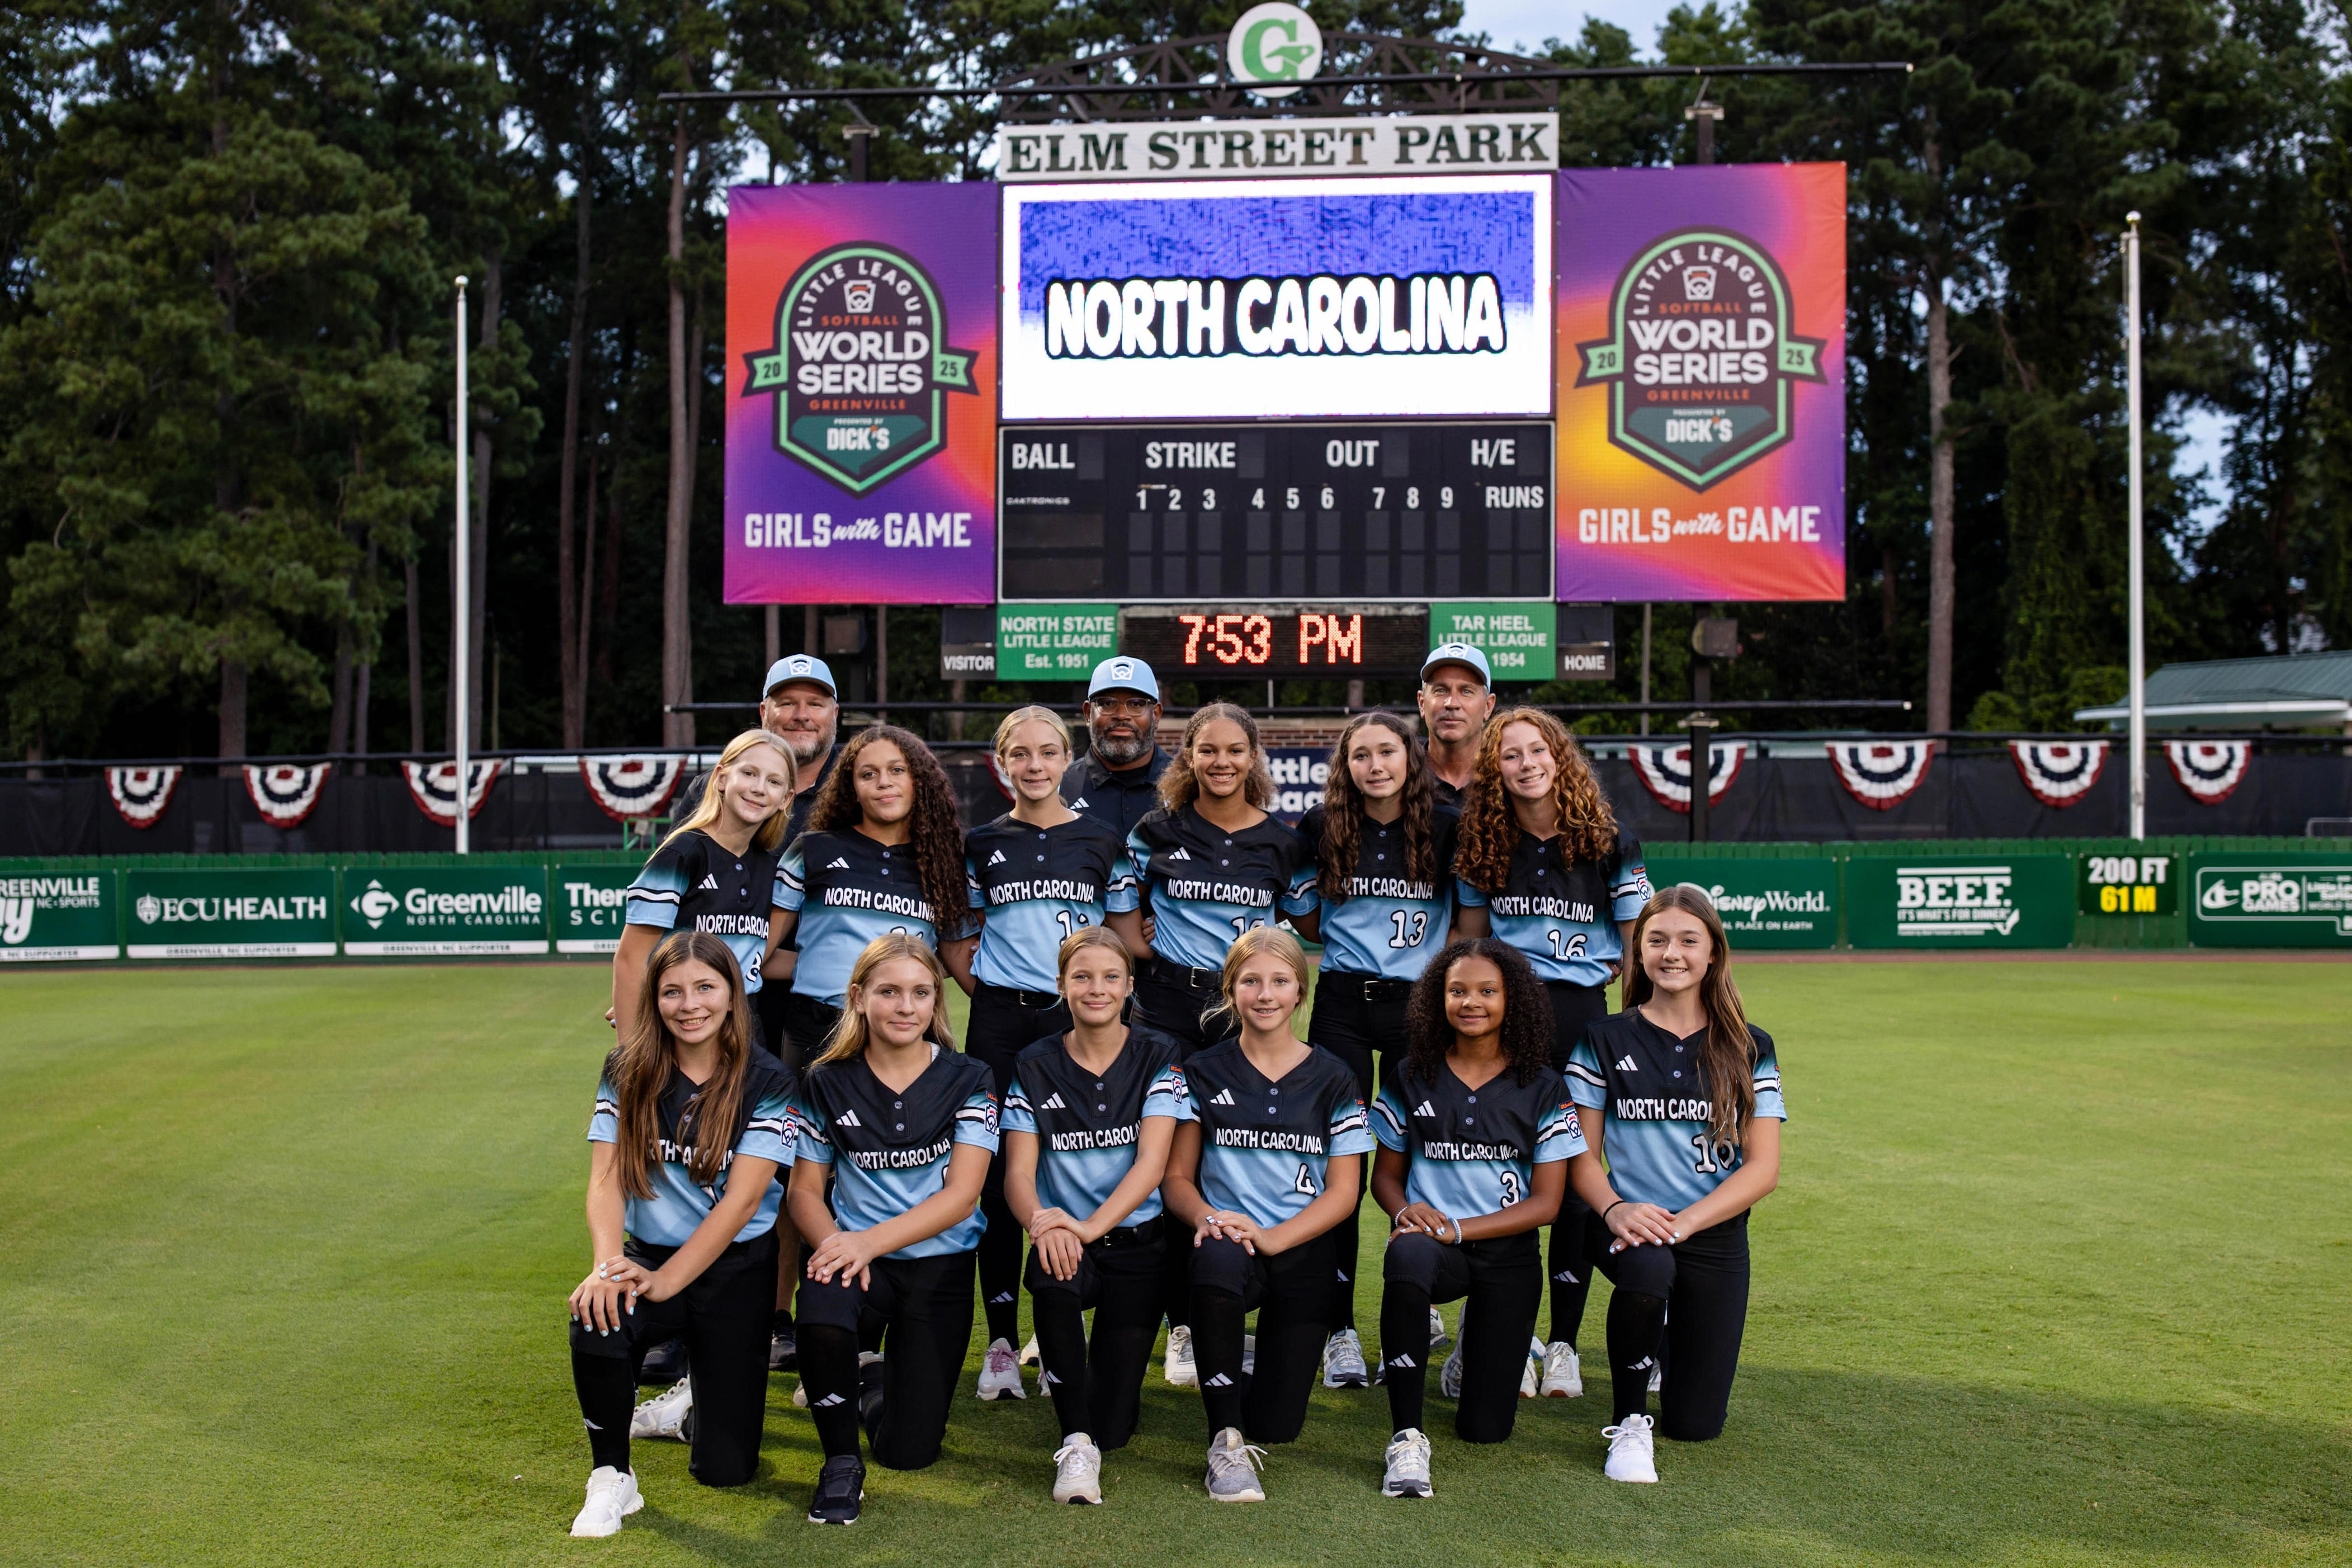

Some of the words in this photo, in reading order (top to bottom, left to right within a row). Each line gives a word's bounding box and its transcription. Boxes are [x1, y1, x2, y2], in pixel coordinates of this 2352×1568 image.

[1007, 134, 1127, 172] ELM
[1149, 127, 1376, 171] STREET
[1395, 122, 1550, 164] PARK
[1633, 249, 1684, 315] LITTLE
[1698, 244, 1767, 314] LEAGUE
[797, 263, 846, 327] LITTLE
[858, 259, 923, 326] LEAGUE
[821, 315, 899, 326] SOFTBALL
[1047, 279, 1226, 357] NORTH
[1236, 276, 1504, 355] CAROLINA
[1659, 302, 1742, 315] SOFTBALL
[792, 331, 930, 361] WORLD
[1628, 318, 1775, 351] WORLD
[940, 361, 958, 377] 25
[1597, 351, 1616, 369] 20
[1633, 352, 1769, 384] SERIES
[1786, 350, 1805, 366] 25
[763, 363, 781, 379] 20
[797, 364, 923, 394] SERIES
[809, 399, 906, 411] GREENVILLE
[1647, 389, 1750, 402] GREENVILLE
[826, 427, 890, 451] DICK'S
[1665, 418, 1732, 443] DICK'S
[1012, 443, 1075, 469] BALL
[1145, 442, 1236, 469] STRIKE
[1326, 440, 1380, 467] OUT
[1471, 438, 1515, 468] H/E
[1136, 489, 1147, 510] 1
[1169, 489, 1182, 510] 2
[1202, 489, 1216, 510] 3
[1251, 488, 1265, 509] 4
[1286, 488, 1300, 509] 5
[1321, 487, 1334, 509] 6
[1372, 487, 1385, 509] 7
[1406, 487, 1419, 509] 8
[1441, 487, 1453, 509] 9
[1485, 486, 1544, 509] RUNS
[745, 513, 832, 547] GIRLS
[832, 519, 882, 541] with
[884, 512, 972, 547] GAME
[1579, 508, 1671, 544] GIRLS
[1672, 512, 1726, 536] with
[1727, 506, 1820, 542] GAME
[1000, 617, 1060, 633] NORTH
[1062, 616, 1115, 632] STATE
[1452, 615, 1486, 631] TAR
[1490, 615, 1534, 631] HEEL
[1004, 634, 1051, 648] LITTLE
[1054, 634, 1111, 648] LEAGUE
[1179, 615, 1271, 664] 7:53
[1300, 614, 1361, 664] PM
[1438, 633, 1485, 647] LITTLE
[1489, 632, 1547, 647] LEAGUE
[943, 655, 995, 671] VISITOR
[1025, 654, 1053, 668] Est.
[1056, 654, 1089, 668] 1951
[1491, 652, 1526, 668] 1954
[1565, 655, 1605, 670] HOME
[2088, 857, 2137, 884] 200
[2141, 857, 2169, 884] FT
[404, 885, 542, 914] Greenville
[564, 882, 627, 907] Ther
[989, 881, 1030, 905] NORTH
[1033, 879, 1094, 904] CAROLINA
[1168, 878, 1211, 900] NORTH
[1213, 883, 1273, 907] CAROLINA
[1371, 877, 1433, 900] CAROLINA
[2100, 886, 2131, 913] 61
[2134, 886, 2156, 913] M
[2242, 880, 2301, 900] PRO
[161, 898, 220, 922] ECU
[224, 896, 327, 920] HEALTH
[824, 887, 871, 909] NORTH
[873, 892, 936, 923] CAROLINA
[1491, 896, 1529, 915] NORTH
[1532, 896, 1594, 923] CAROLINA
[1952, 908, 1971, 921] FOR
[2241, 899, 2301, 912] GAMES
[407, 915, 456, 926] NORTH
[465, 914, 541, 925] CAROLINA
[696, 914, 736, 934] NORTH
[1388, 910, 1427, 948] 13
[1735, 921, 1763, 930] PLACE
[1765, 921, 1780, 930] ON
[1783, 921, 1813, 930] EARTH
[1547, 929, 1588, 961] 16
[1617, 1098, 1665, 1119] NORTH
[848, 1150, 889, 1169] NORTH
[890, 1137, 951, 1168] CAROLINA
[1052, 1131, 1094, 1151] NORTH
[1216, 1128, 1258, 1148] NORTH
[1261, 1131, 1324, 1154] CAROLINA
[1425, 1140, 1460, 1160] NORTH
[1462, 1142, 1519, 1160] CAROLINA
[1295, 1163, 1316, 1195] 4
[1500, 1171, 1520, 1209] 3
